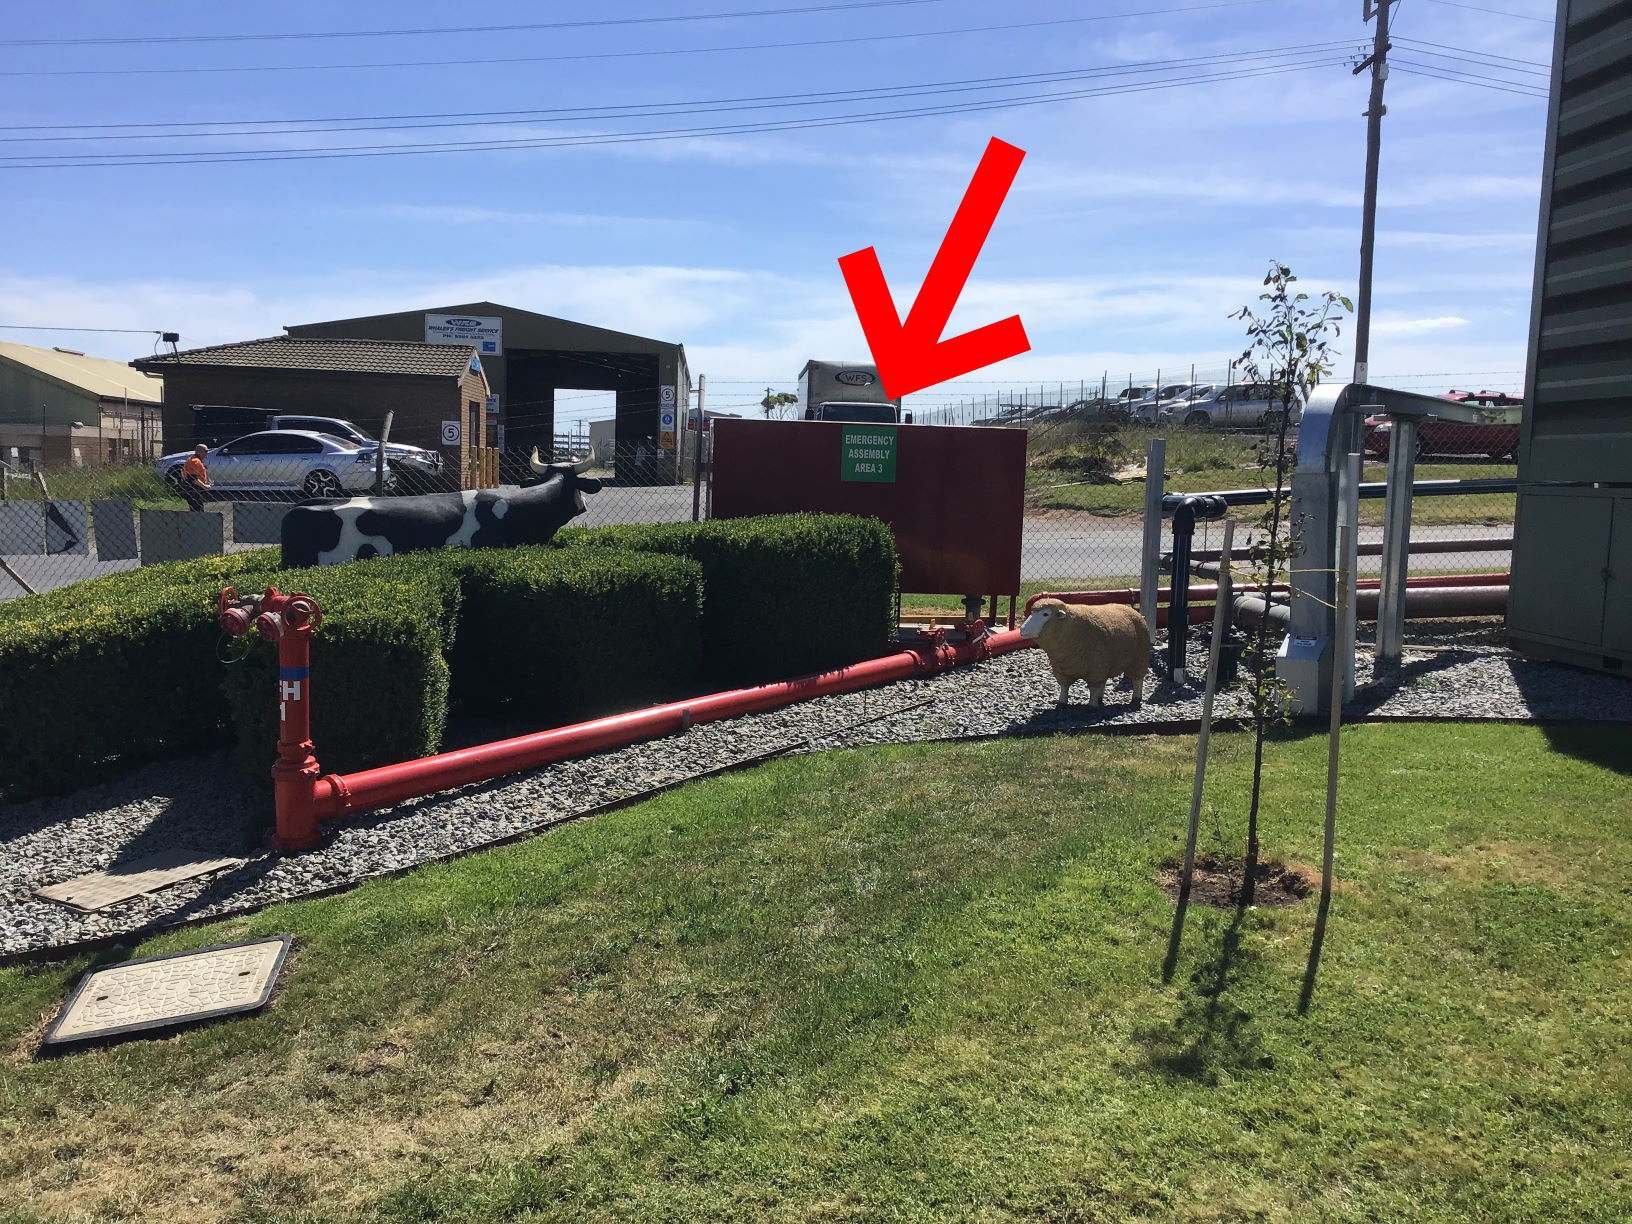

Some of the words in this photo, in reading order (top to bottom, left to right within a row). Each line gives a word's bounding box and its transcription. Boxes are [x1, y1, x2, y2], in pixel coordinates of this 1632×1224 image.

[845, 374, 868, 382] WFS
[665, 391, 670, 399] 5
[448, 428, 454, 438] 5
[845, 434, 894, 446] EMERGENCY
[848, 448, 890, 459] ASSEMBLY
[854, 463, 876, 473] AREA
[877, 463, 883, 473] 3
[279, 680, 300, 701] H
